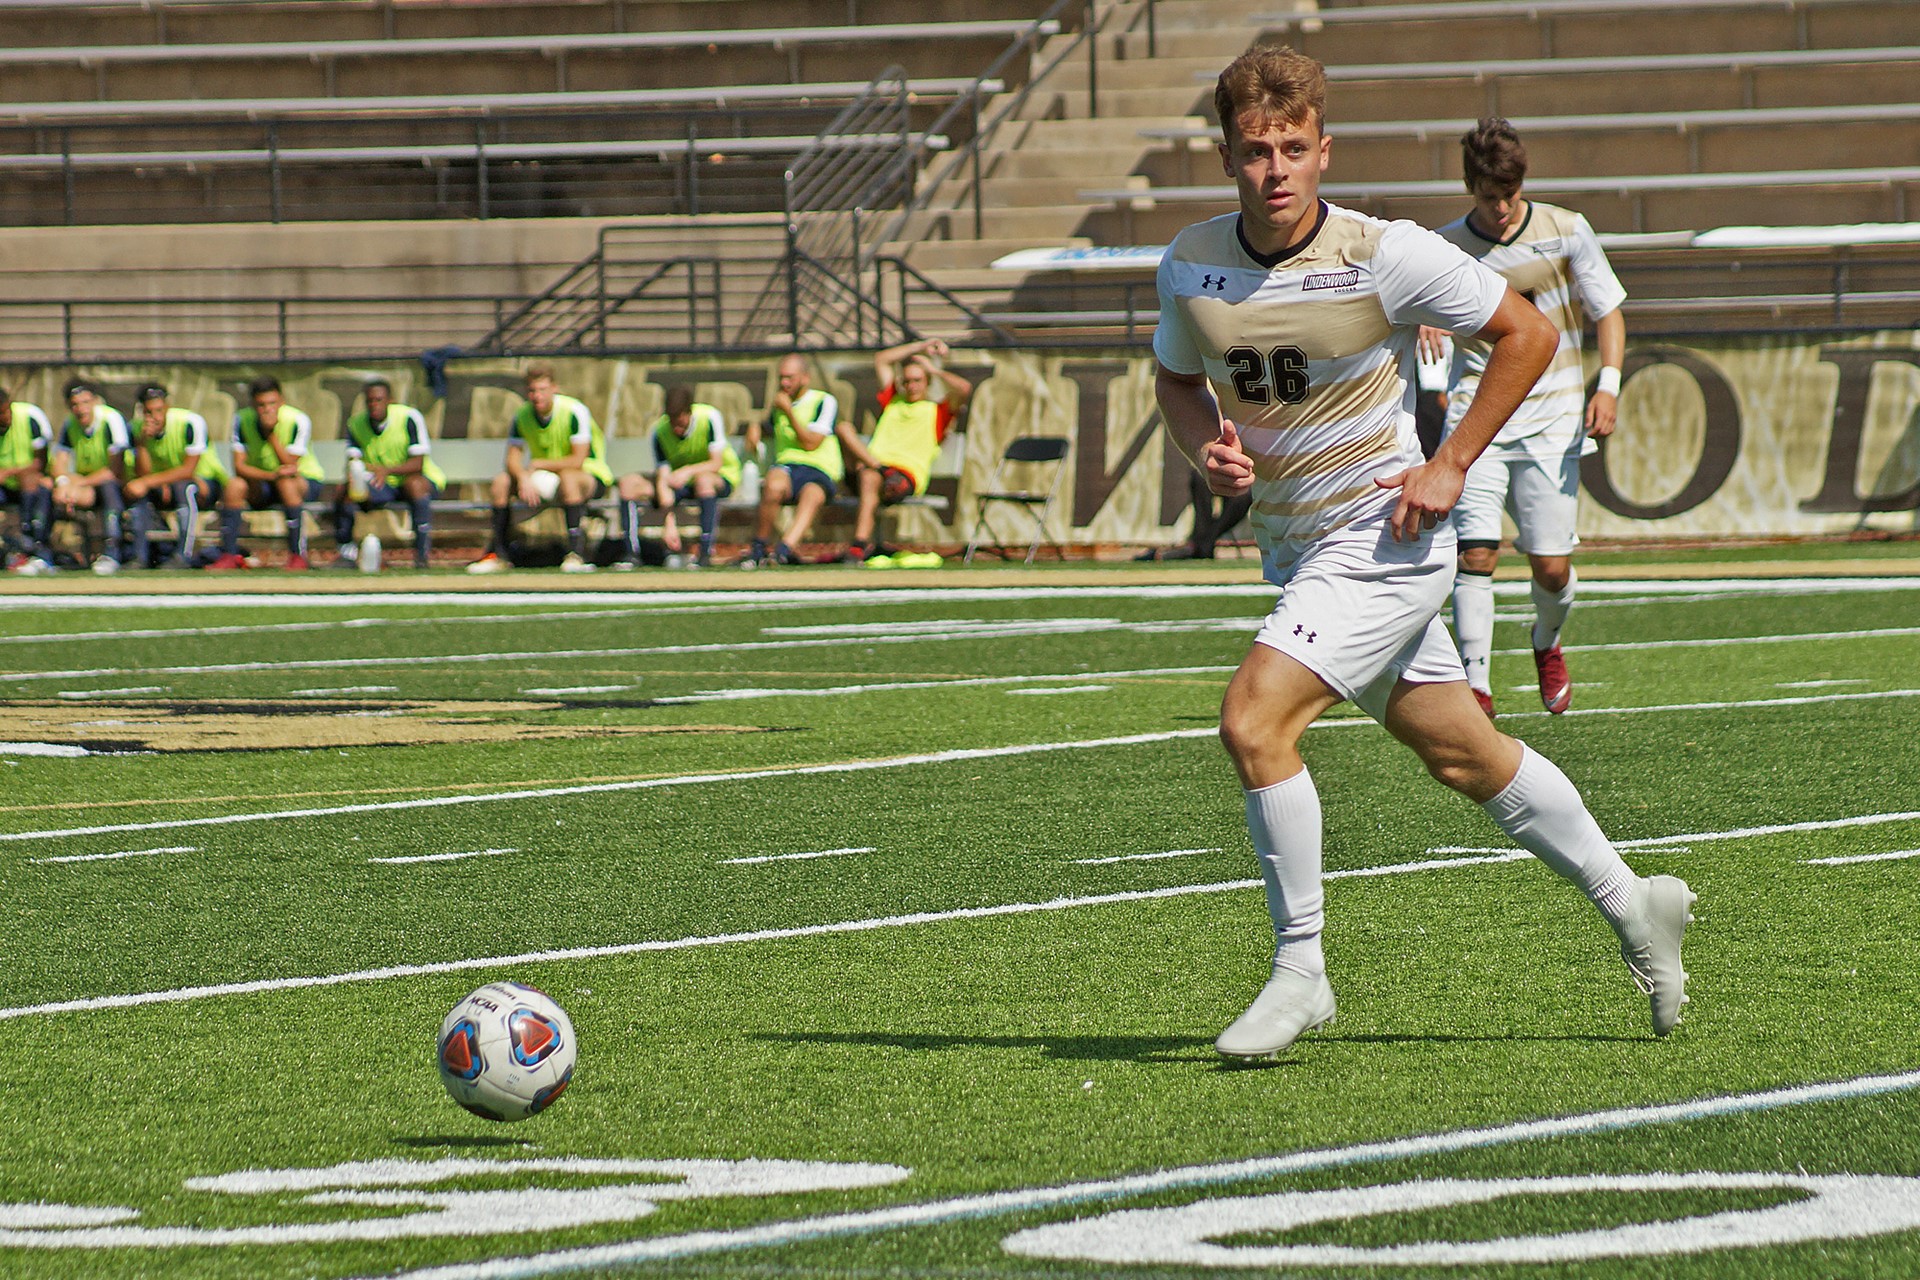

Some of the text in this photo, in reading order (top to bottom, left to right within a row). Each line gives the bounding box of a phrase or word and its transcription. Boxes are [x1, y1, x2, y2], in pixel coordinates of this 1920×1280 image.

[1303, 271, 1360, 291] LINDENWOOD
[1224, 346, 1310, 406] 26
[467, 995, 499, 1013] NCAA
